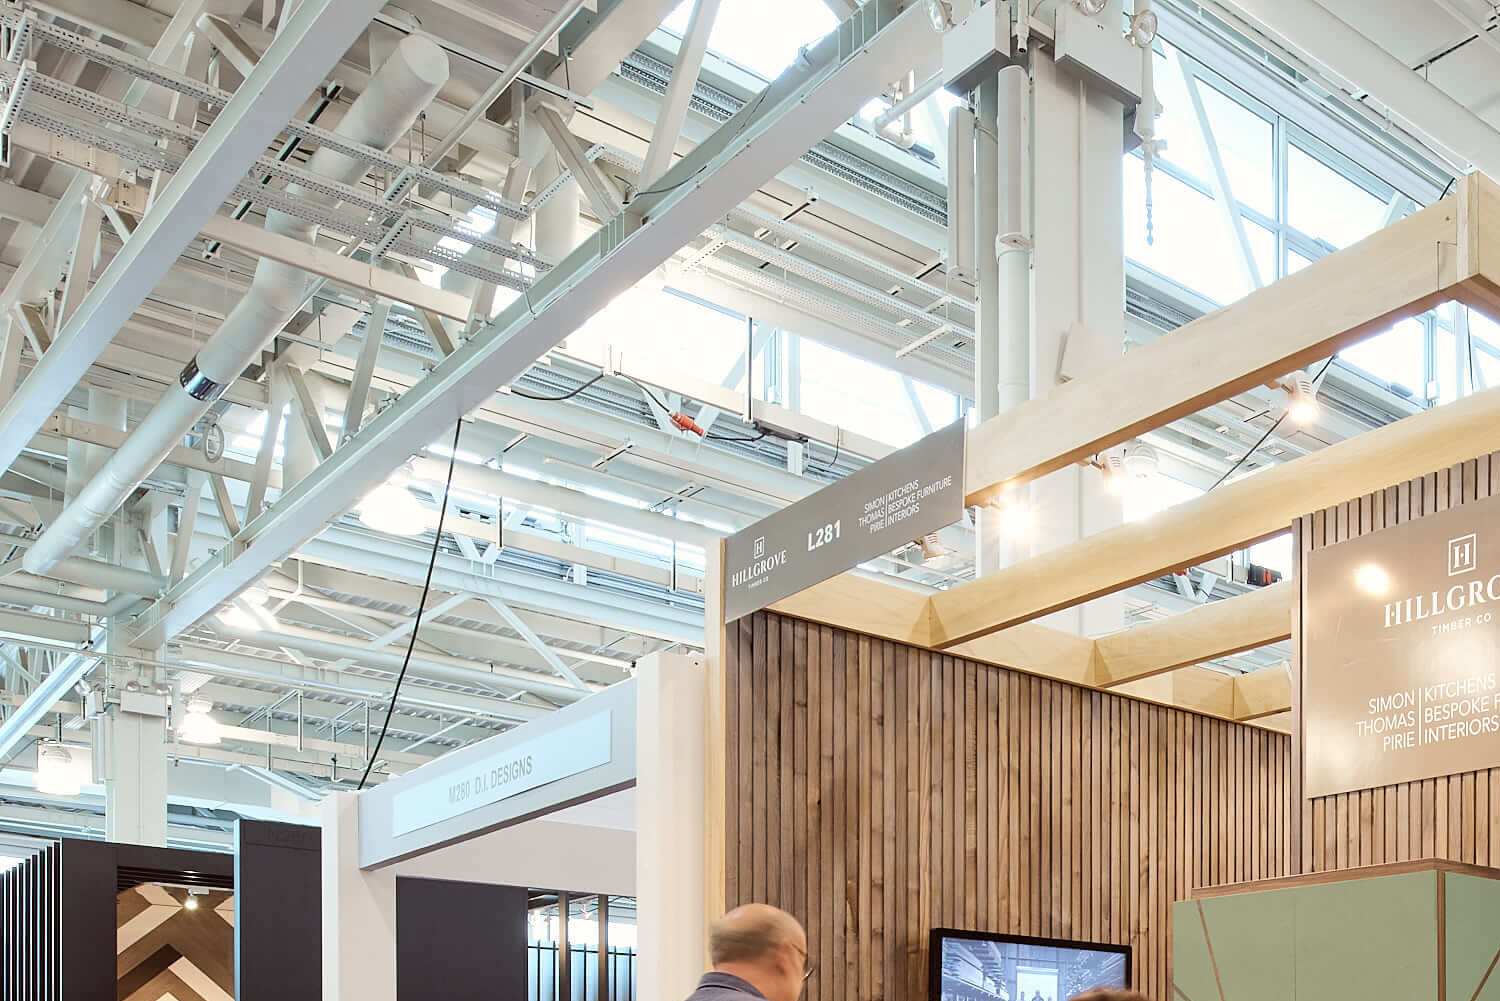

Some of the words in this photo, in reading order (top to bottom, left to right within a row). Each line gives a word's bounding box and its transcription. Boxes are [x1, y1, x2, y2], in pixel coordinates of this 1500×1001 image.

[888, 480, 919, 502] KITCHENS
[888, 492, 916, 514] BESPOKE
[917, 476, 952, 500] FURNITURE
[859, 507, 885, 527] THOMAS
[864, 496, 885, 513] SIMON
[888, 502, 919, 526] INTERIORS
[808, 519, 840, 552] L281
[732, 549, 787, 588] HILLGROVE
[1431, 618, 1472, 635] TIMBER
[1476, 612, 1492, 625] CO
[1425, 672, 1496, 702] KITCHENS
[1368, 689, 1415, 714] SIMON
[1425, 695, 1490, 723] BESPOKE
[1356, 711, 1415, 737] THOMAS
[1425, 715, 1500, 744] INTERIORS
[1383, 731, 1415, 752] PIRIE
[491, 755, 532, 788] DESIGNS
